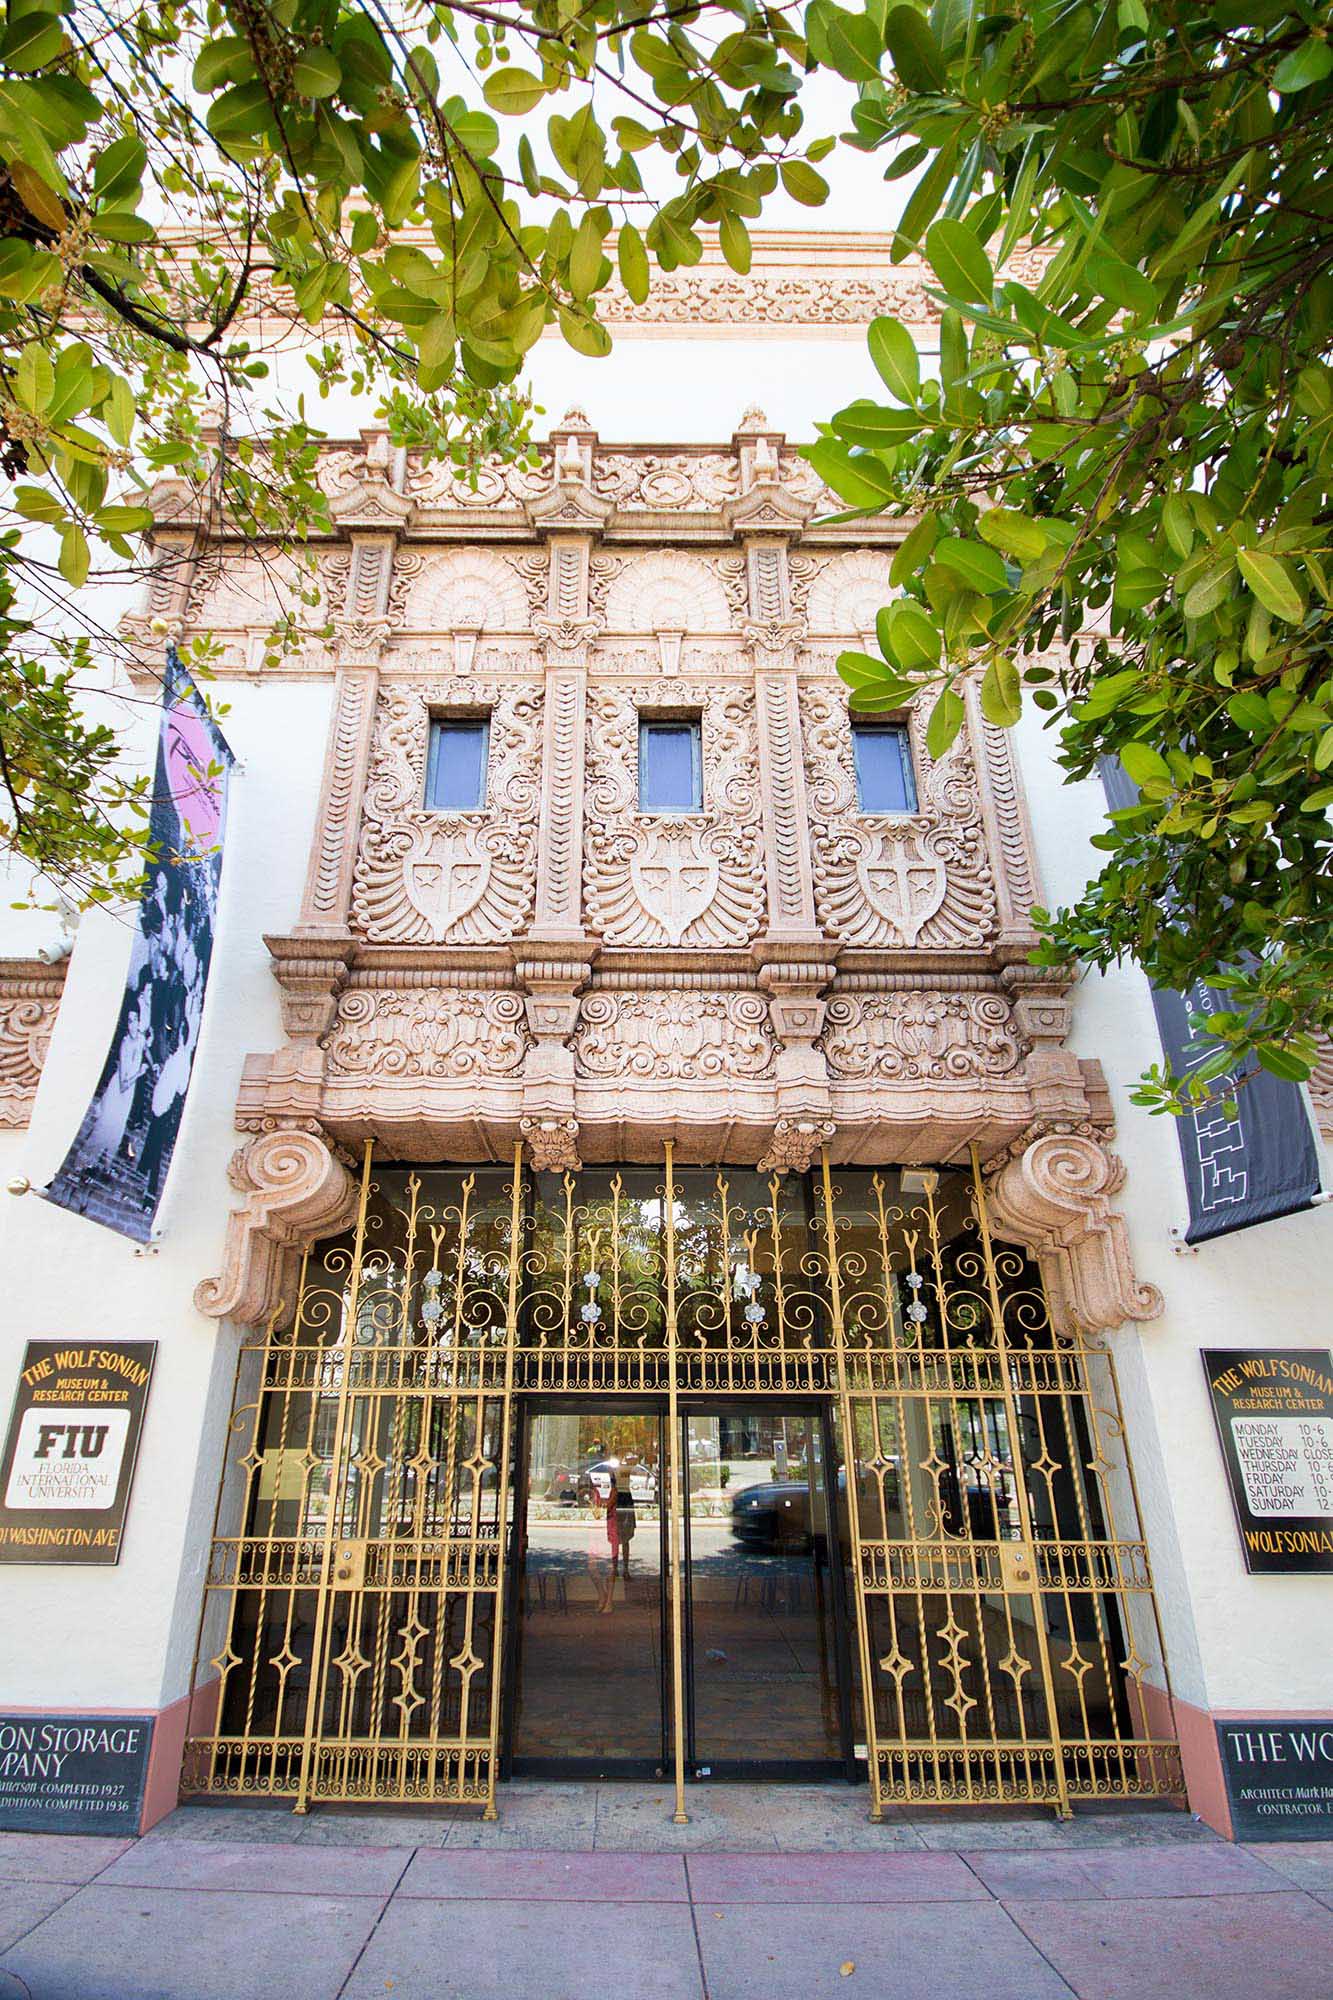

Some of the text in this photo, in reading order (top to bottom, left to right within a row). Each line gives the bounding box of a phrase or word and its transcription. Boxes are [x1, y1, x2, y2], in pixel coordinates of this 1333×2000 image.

[21, 1349, 150, 1388] THE WOLFSONIAN
[56, 1378, 108, 1390] MUSEUM &
[1212, 1367, 1243, 1397] THE
[32, 1389, 129, 1402] RESEARCH CENTER
[1250, 1387, 1303, 1399] MUSEUM &
[1232, 1398, 1325, 1410] RESEARCH CENTER
[1235, 1423, 1279, 1436] MONDAY
[34, 1425, 109, 1458] FIU
[1238, 1436, 1283, 1448] TUESDAY
[1239, 1448, 1299, 1460] WEDNESDAY
[38, 1463, 89, 1474] FLORIDA
[1243, 1460, 1297, 1472] THURSDAY
[17, 1474, 110, 1485] INTERNATIONAL
[1246, 1473, 1285, 1485] FRIDAY
[28, 1486, 96, 1498] UNIVERSITY
[1249, 1485, 1304, 1498] SATURDAY
[1252, 1498, 1296, 1511] SUNDAY
[10, 1526, 93, 1546] WASHINGTON
[1245, 1530, 1333, 1553] WOLFSONIA
[0, 1722, 139, 1753] ON STORAGE
[1228, 1733, 1286, 1761] THE
[40, 1784, 99, 1795] COMPLETED
[101, 1784, 125, 1797] 1927
[1240, 1789, 1293, 1799] ARCHITECT
[1295, 1786, 1320, 1799] Mark
[46, 1799, 104, 1810] COMPLETED
[106, 1800, 130, 1812] 1936
[1257, 1804, 1323, 1814] CONTRACTOR
